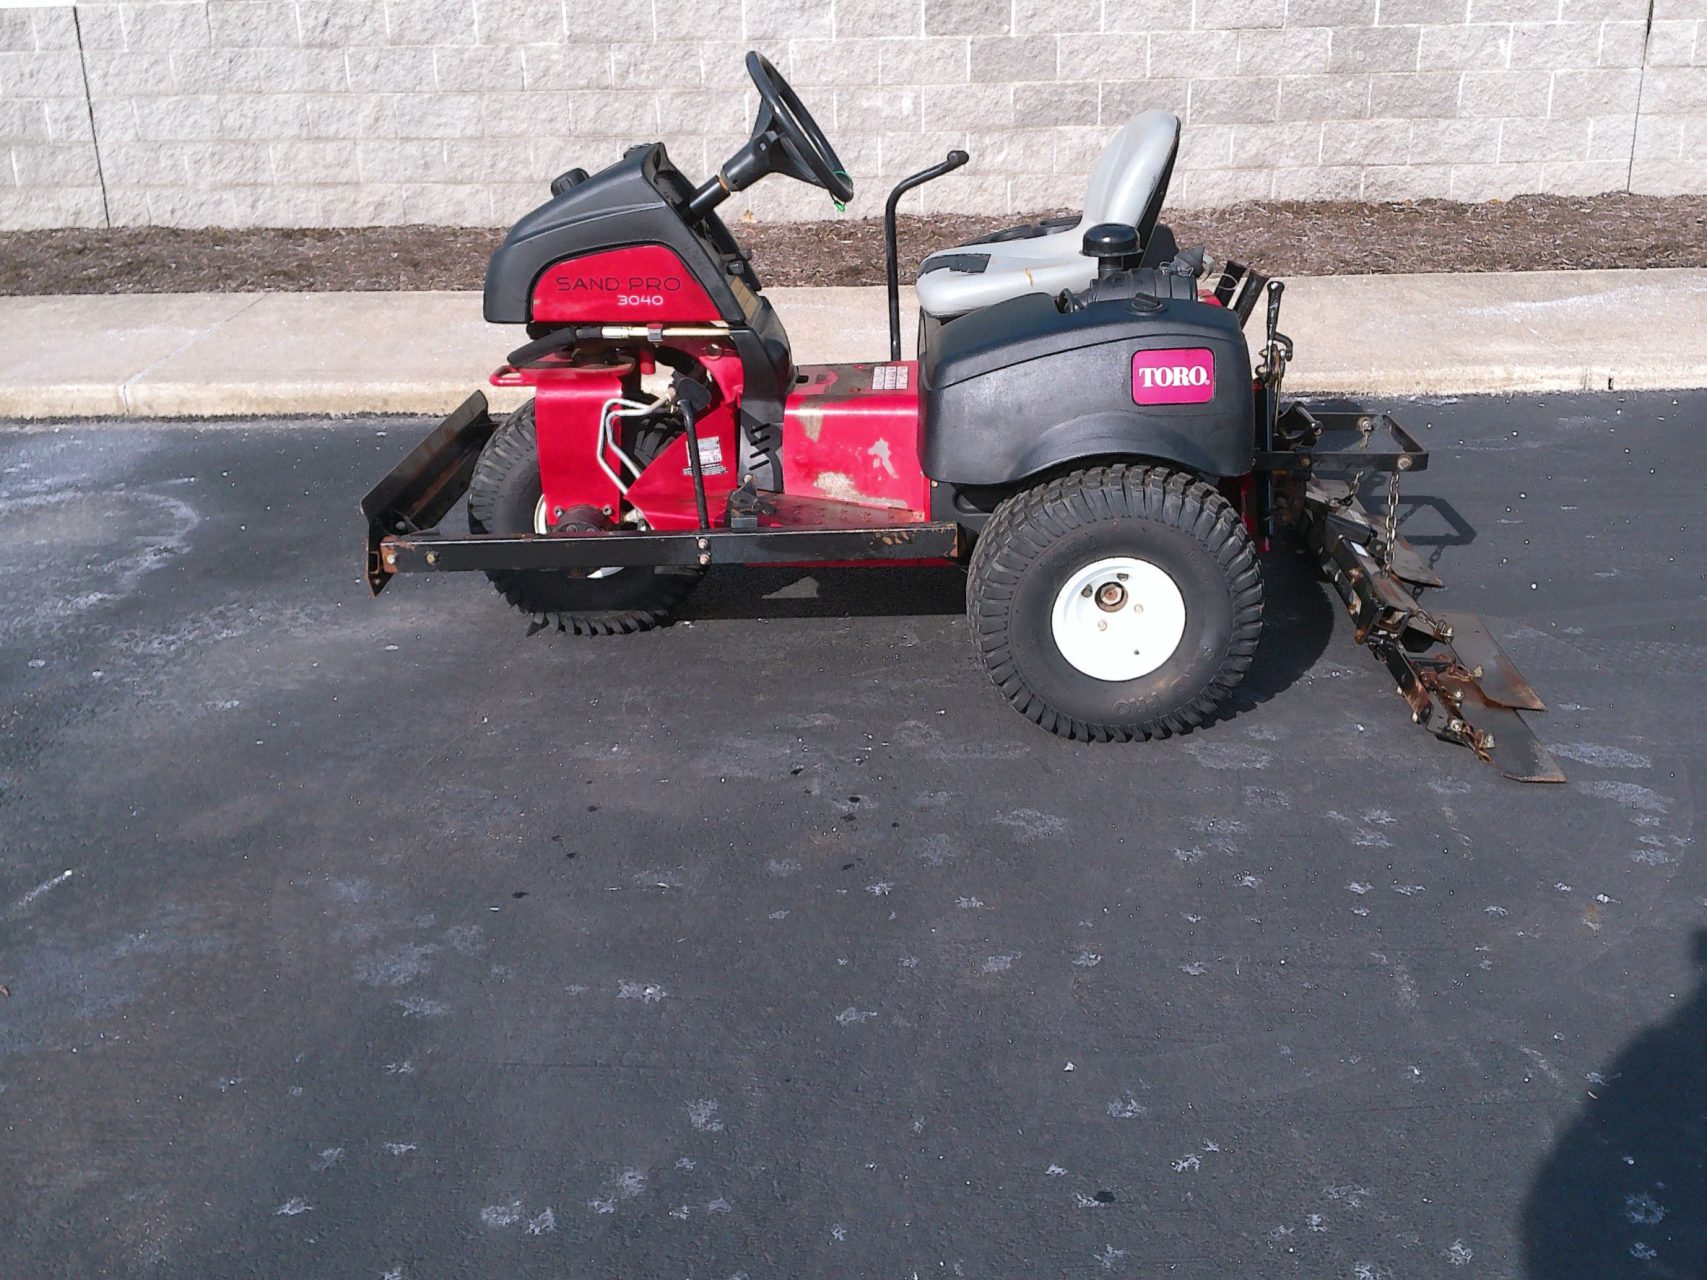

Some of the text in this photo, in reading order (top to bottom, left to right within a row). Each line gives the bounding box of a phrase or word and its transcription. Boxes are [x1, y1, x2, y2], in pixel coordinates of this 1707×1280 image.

[556, 276, 681, 292] SAND PRO
[617, 295, 664, 306] 3040
